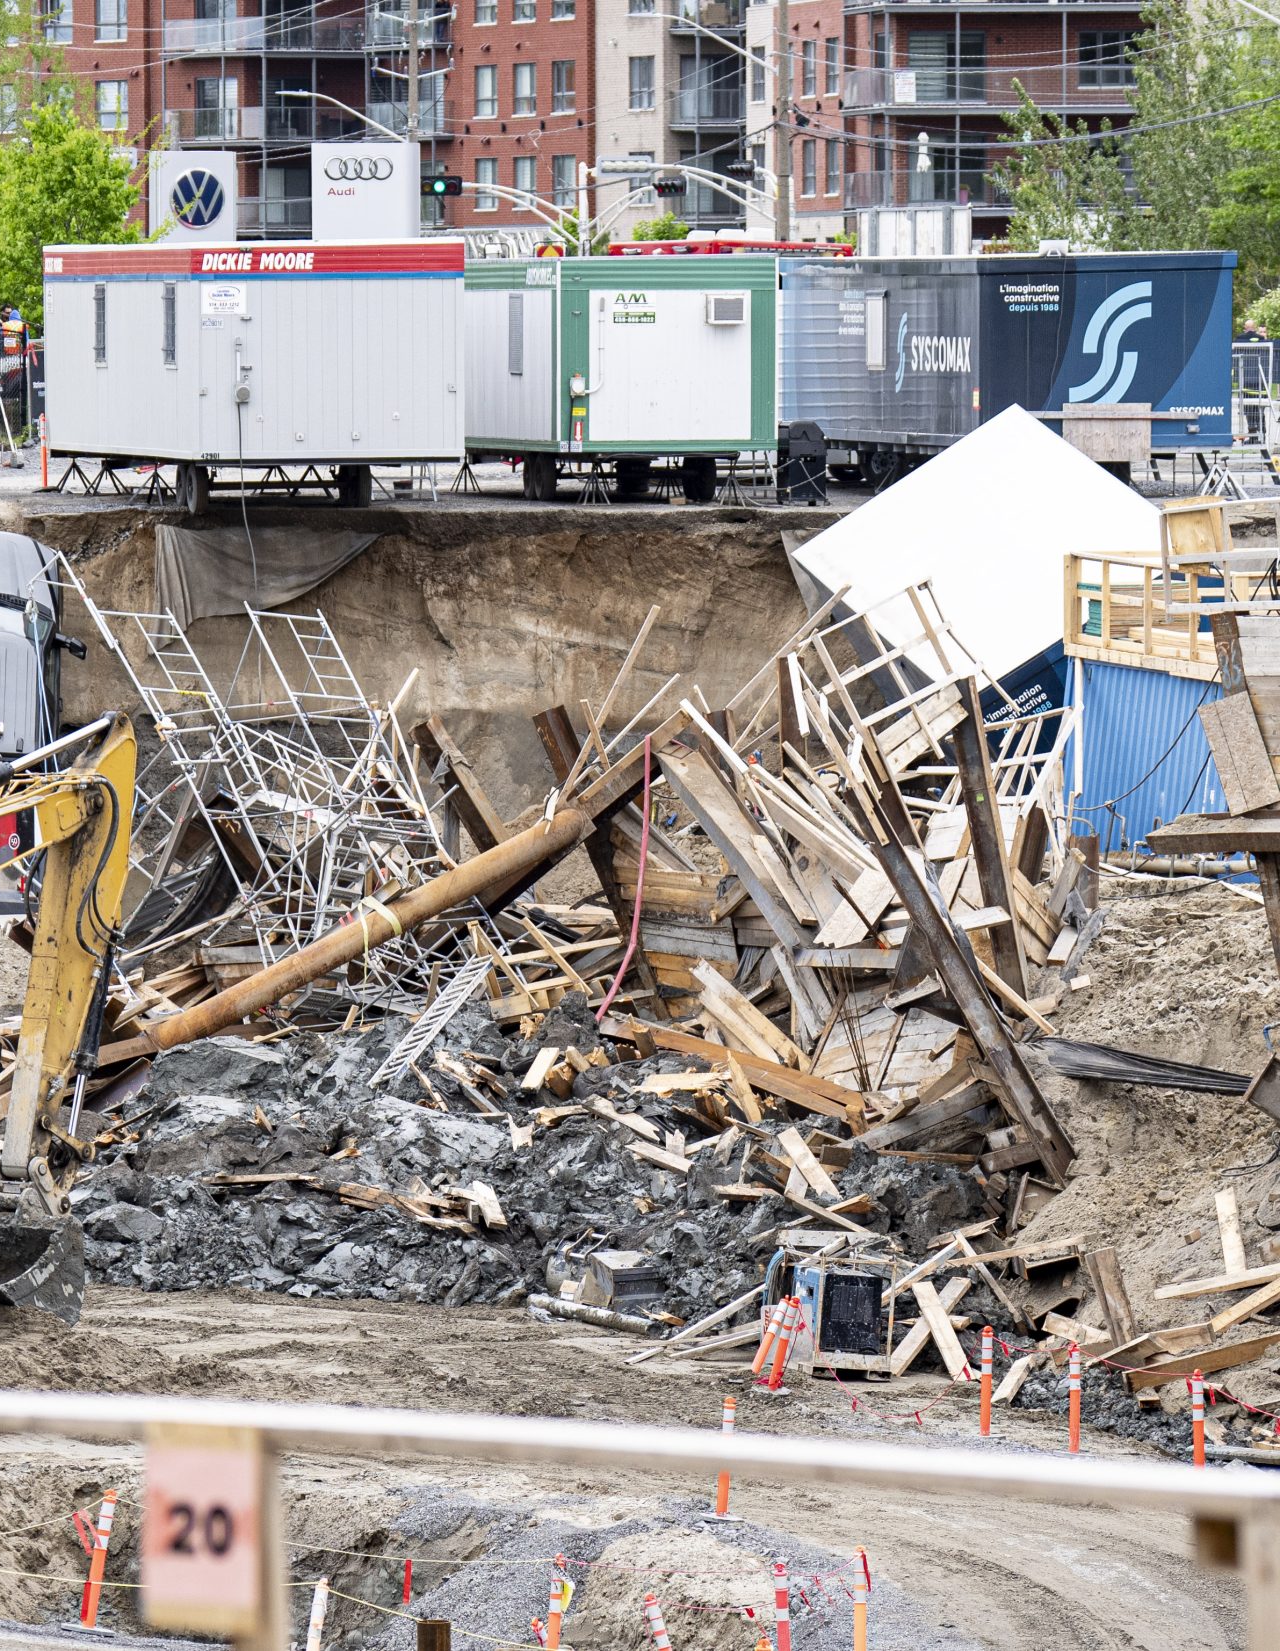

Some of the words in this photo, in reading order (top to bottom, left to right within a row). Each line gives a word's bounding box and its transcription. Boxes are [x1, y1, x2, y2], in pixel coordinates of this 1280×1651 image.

[327, 187, 355, 196] Audi
[201, 253, 253, 270] DICKIE
[260, 252, 314, 270] MOORE
[999, 284, 1060, 294] L'imagination
[1004, 293, 1060, 302] constructive
[1009, 303, 1039, 312] depuis
[1040, 303, 1059, 311] 1988
[911, 336, 971, 373] SYSCOMAX
[983, 683, 1042, 724] L'imagnation
[165, 1501, 236, 1560] 20
